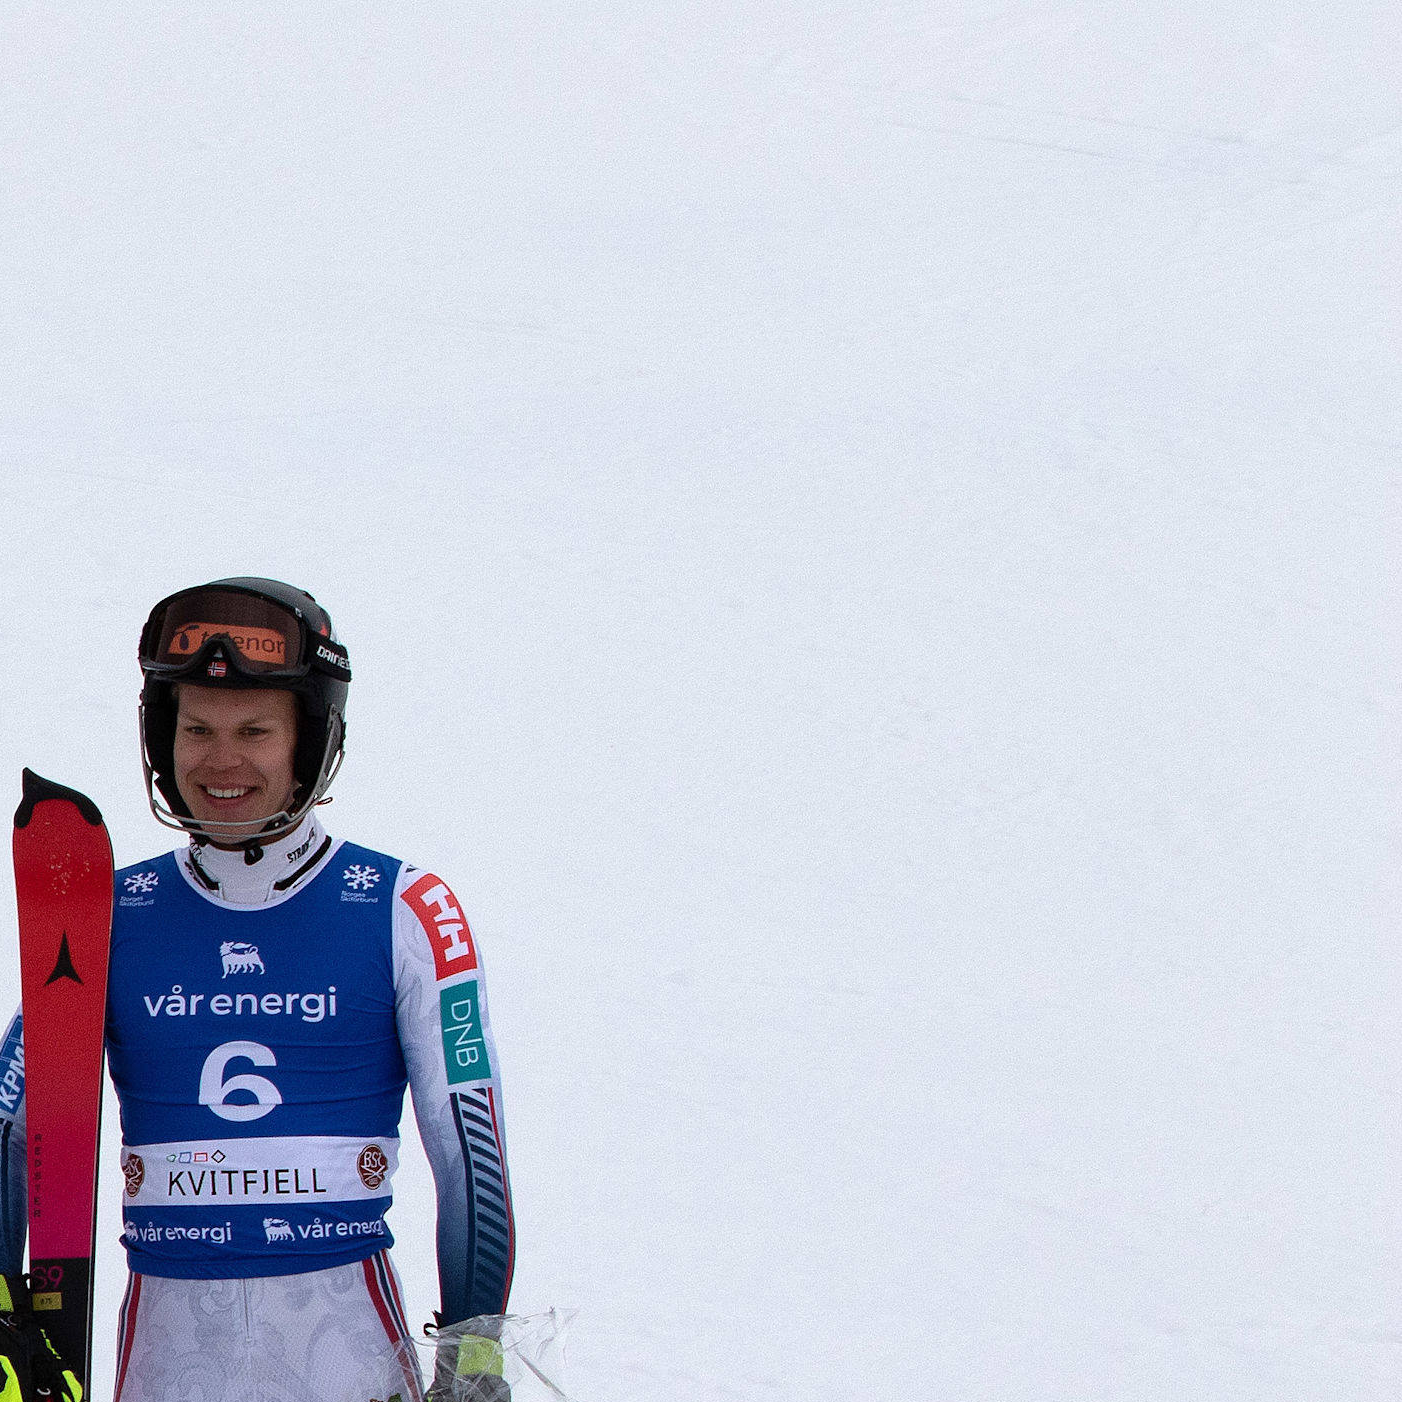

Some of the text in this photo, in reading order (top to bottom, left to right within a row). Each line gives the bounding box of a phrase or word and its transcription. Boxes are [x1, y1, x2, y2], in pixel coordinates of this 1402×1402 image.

[420, 883, 470, 963] HH
[144, 984, 337, 1023] vår energi
[444, 999, 482, 1067] DNB
[198, 1040, 283, 1122] 6
[168, 1168, 327, 1196] KVITFJELL
[139, 1222, 232, 1244] vår energi
[298, 1218, 333, 1239] vår
[30, 1265, 64, 1289] S9
